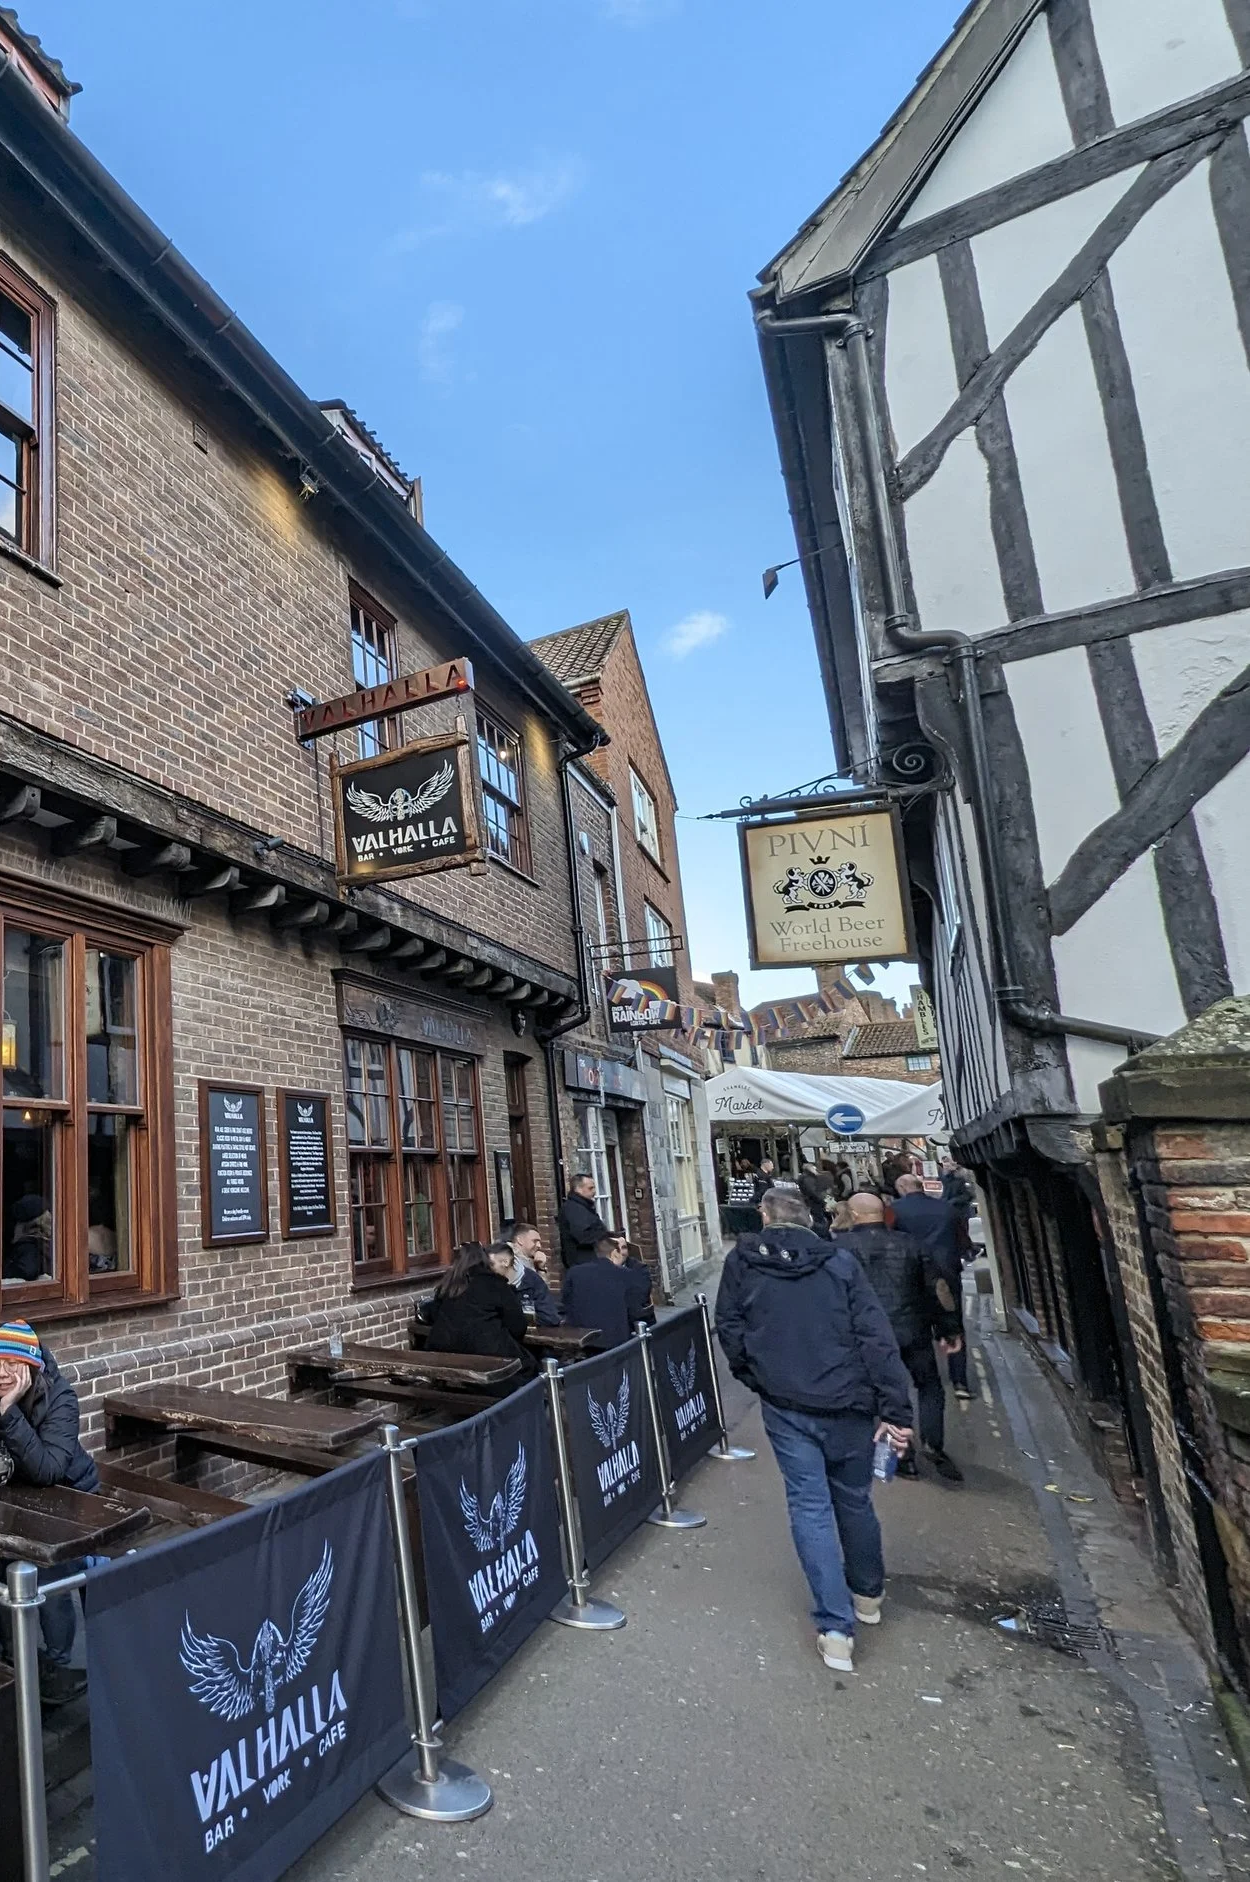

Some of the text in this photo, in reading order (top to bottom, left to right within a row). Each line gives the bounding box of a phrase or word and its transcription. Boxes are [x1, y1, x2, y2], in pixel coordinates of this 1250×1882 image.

[302, 663, 464, 730] VALHALLA
[351, 816, 458, 853] VALHALLA
[357, 836, 456, 862] BAR YORK CAFE
[769, 916, 885, 937] World Beer
[779, 934, 883, 953] Freehouse
[714, 1096, 765, 1116] Market
[596, 1440, 640, 1492] VALHALLA
[480, 1611, 494, 1633] BAR
[522, 1565, 539, 1586] CAFE
[190, 1669, 348, 1823] VALHALLA
[205, 1720, 346, 1854] BAR YORK CAFE
